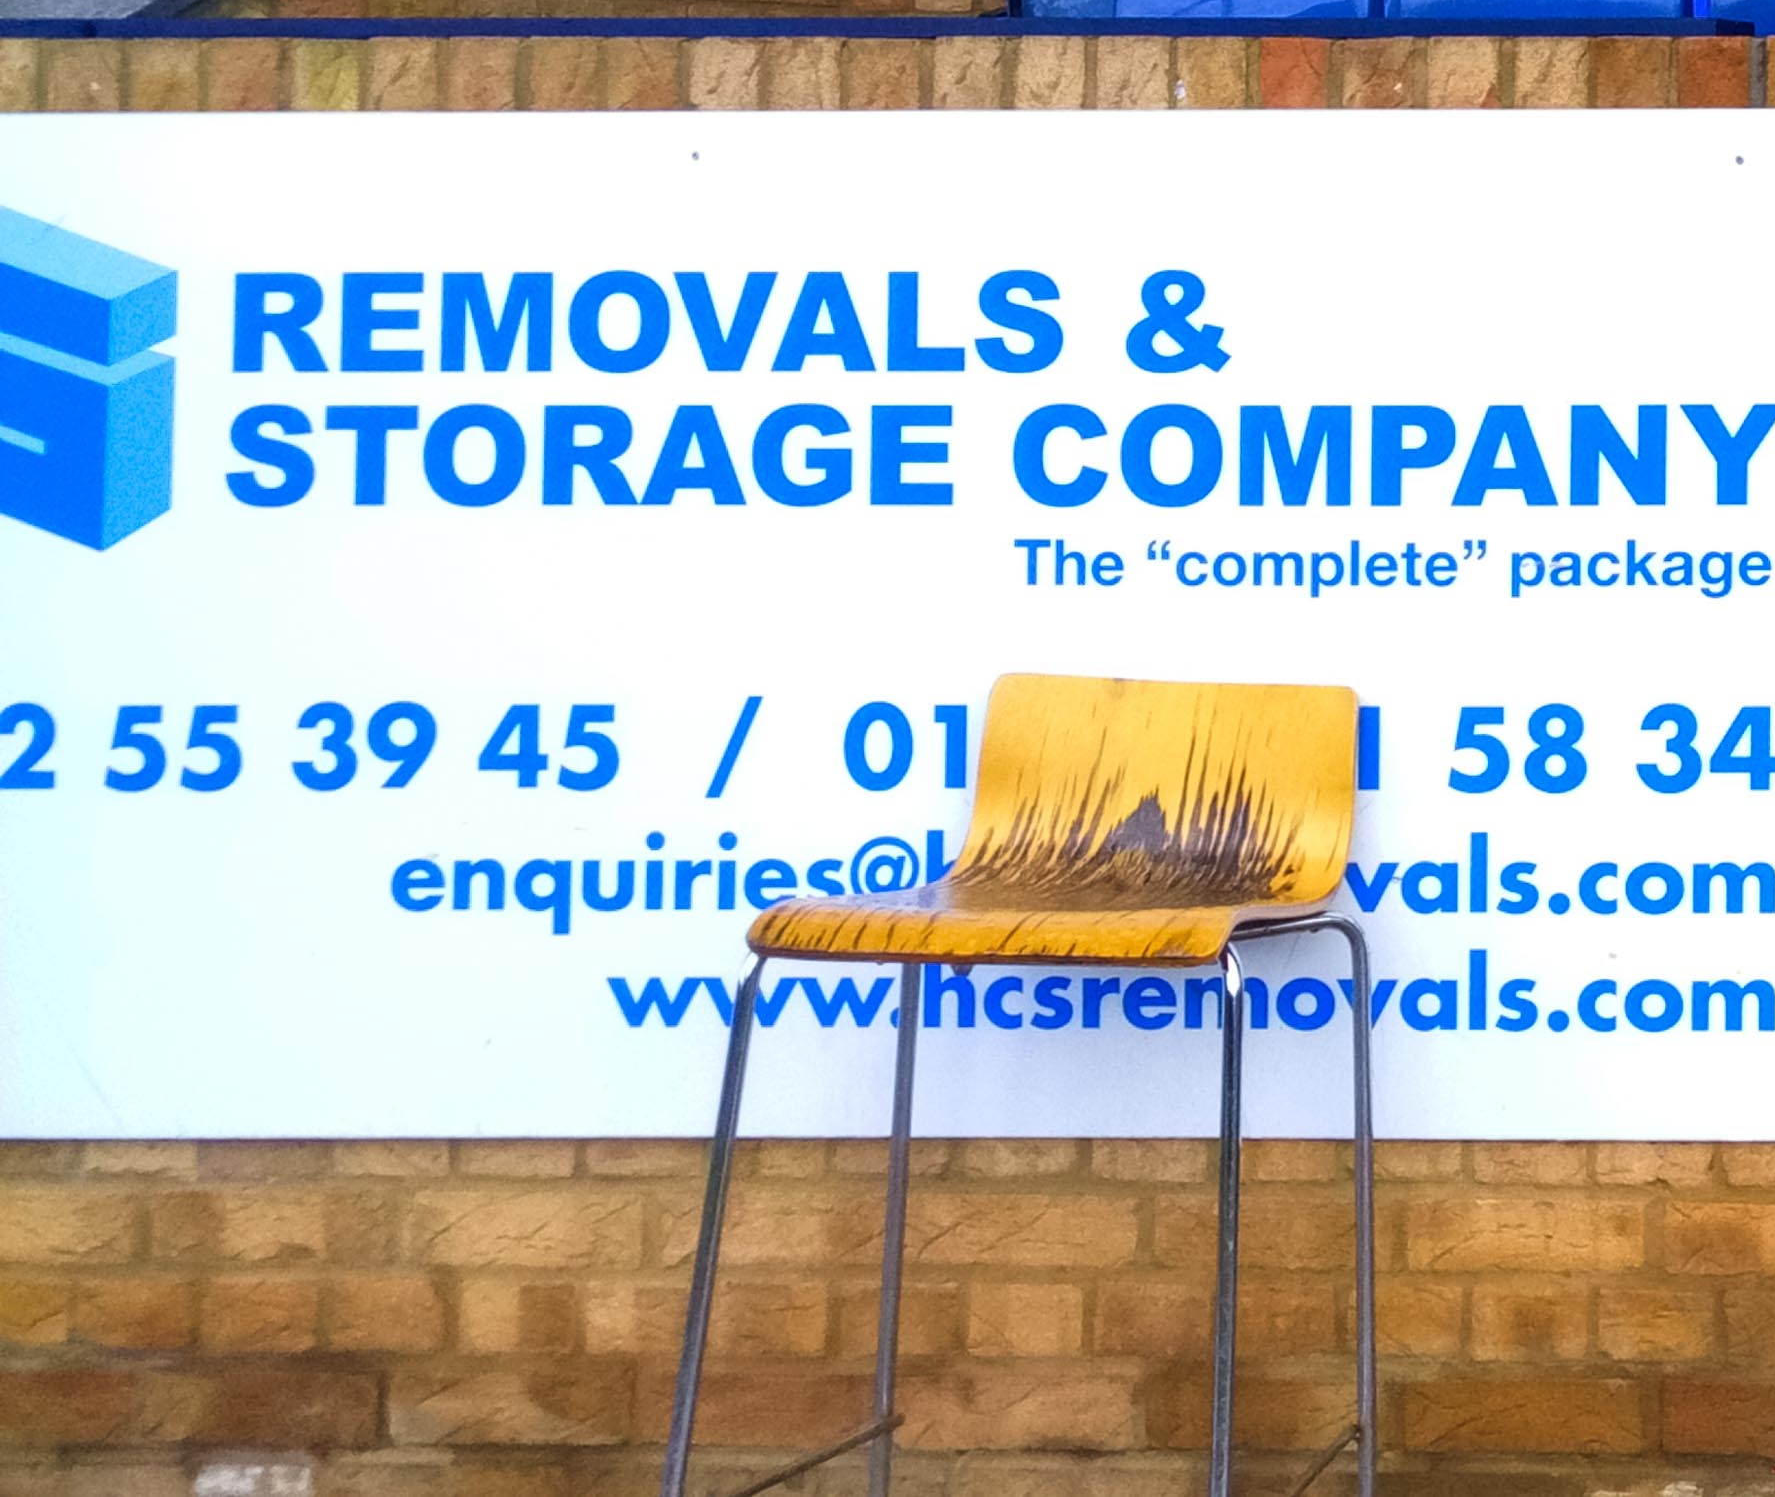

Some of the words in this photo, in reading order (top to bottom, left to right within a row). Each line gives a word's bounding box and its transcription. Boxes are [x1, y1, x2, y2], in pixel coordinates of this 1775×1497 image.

[232, 269, 1064, 374] REMOVALS
[1125, 269, 1231, 374] &
[225, 403, 954, 508] STORAGE
[1013, 538, 1125, 587] The
[1510, 538, 1773, 599] package
[103, 704, 243, 793] 55
[291, 701, 438, 792] 39
[477, 703, 620, 792] 45
[1447, 702, 1588, 795] 58
